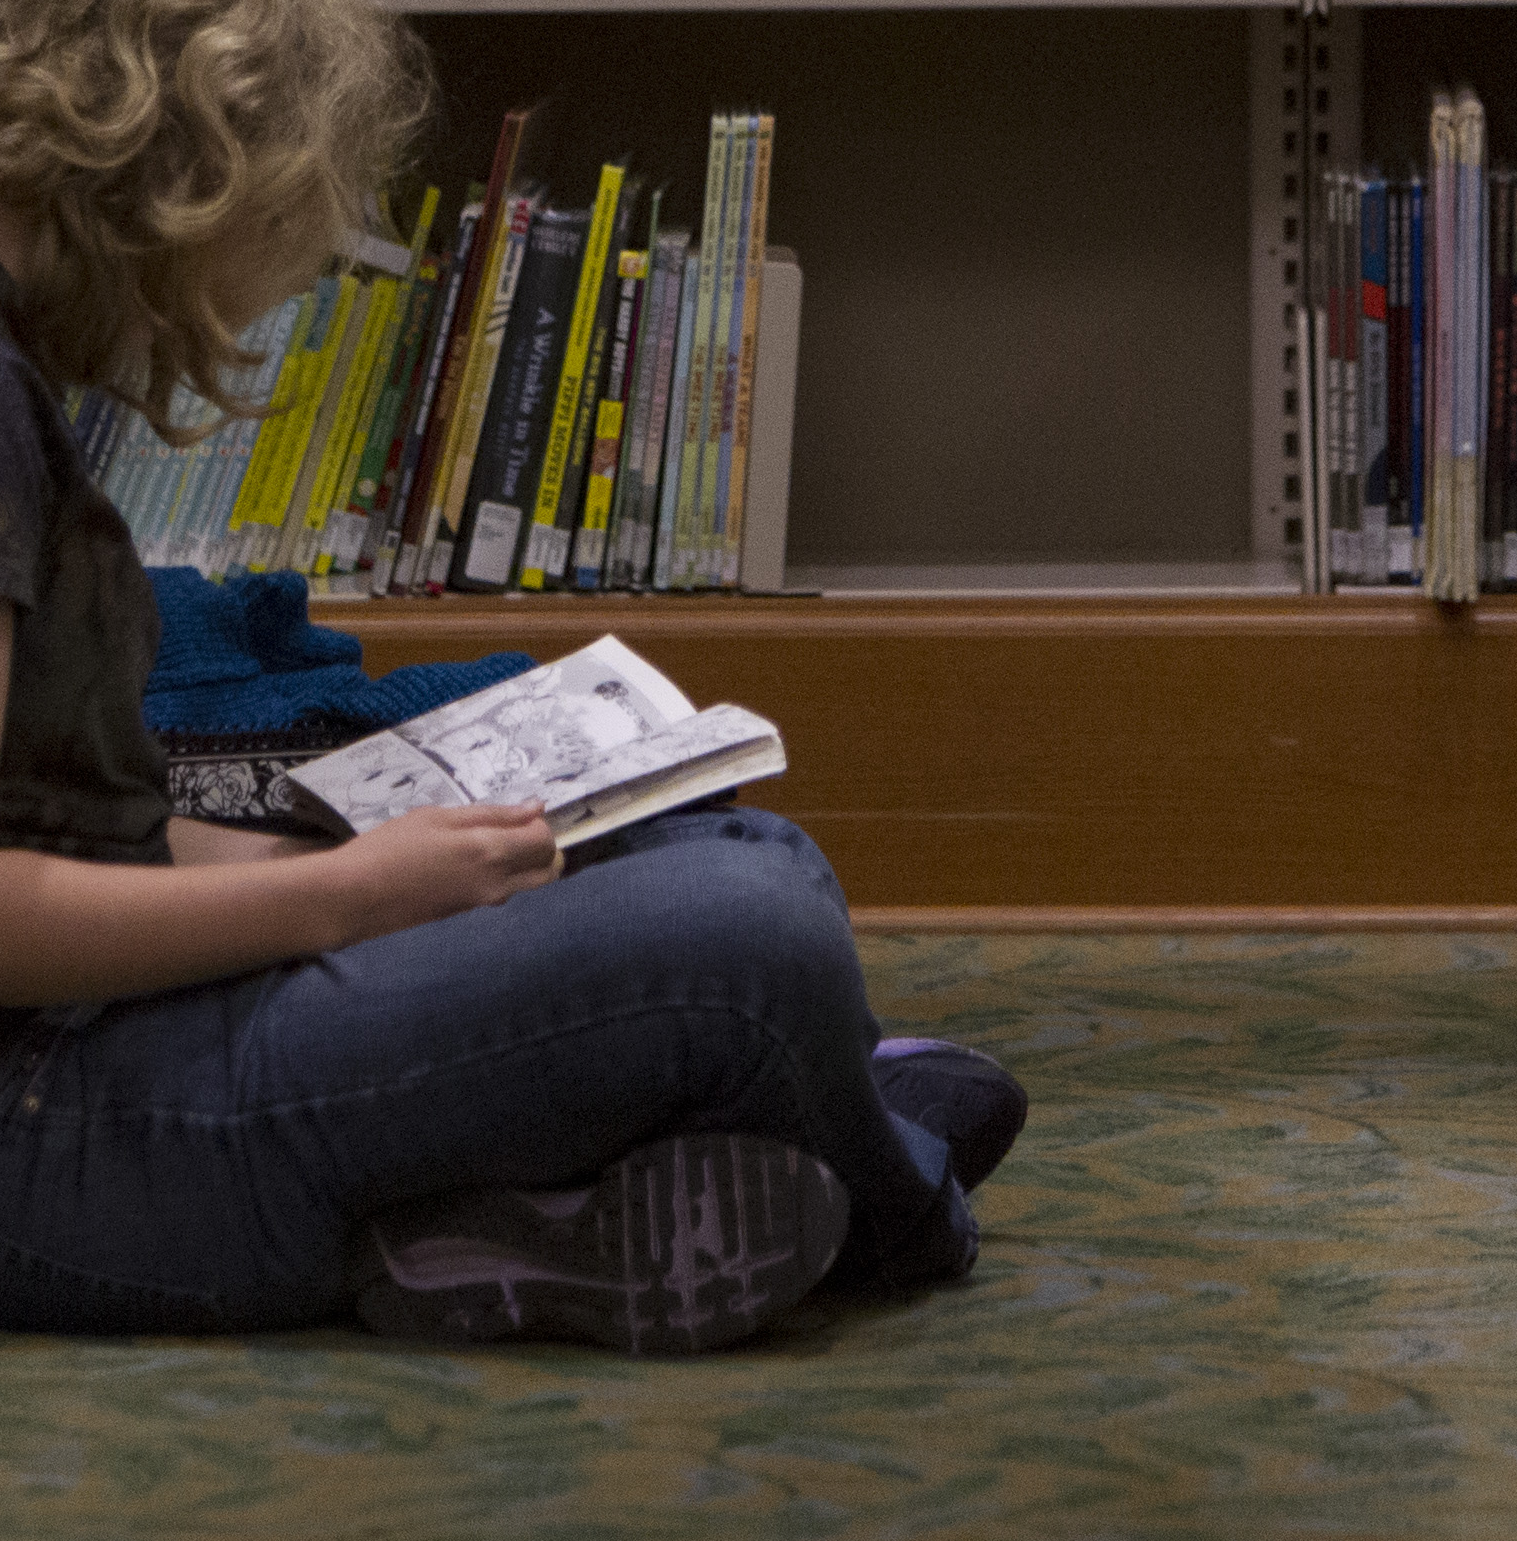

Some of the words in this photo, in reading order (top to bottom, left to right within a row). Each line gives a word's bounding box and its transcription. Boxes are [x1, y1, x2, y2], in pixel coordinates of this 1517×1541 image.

[535, 306, 557, 327] A
[519, 332, 553, 414] Wrinkle
[500, 445, 528, 499] Time
[540, 480, 557, 509] IN
